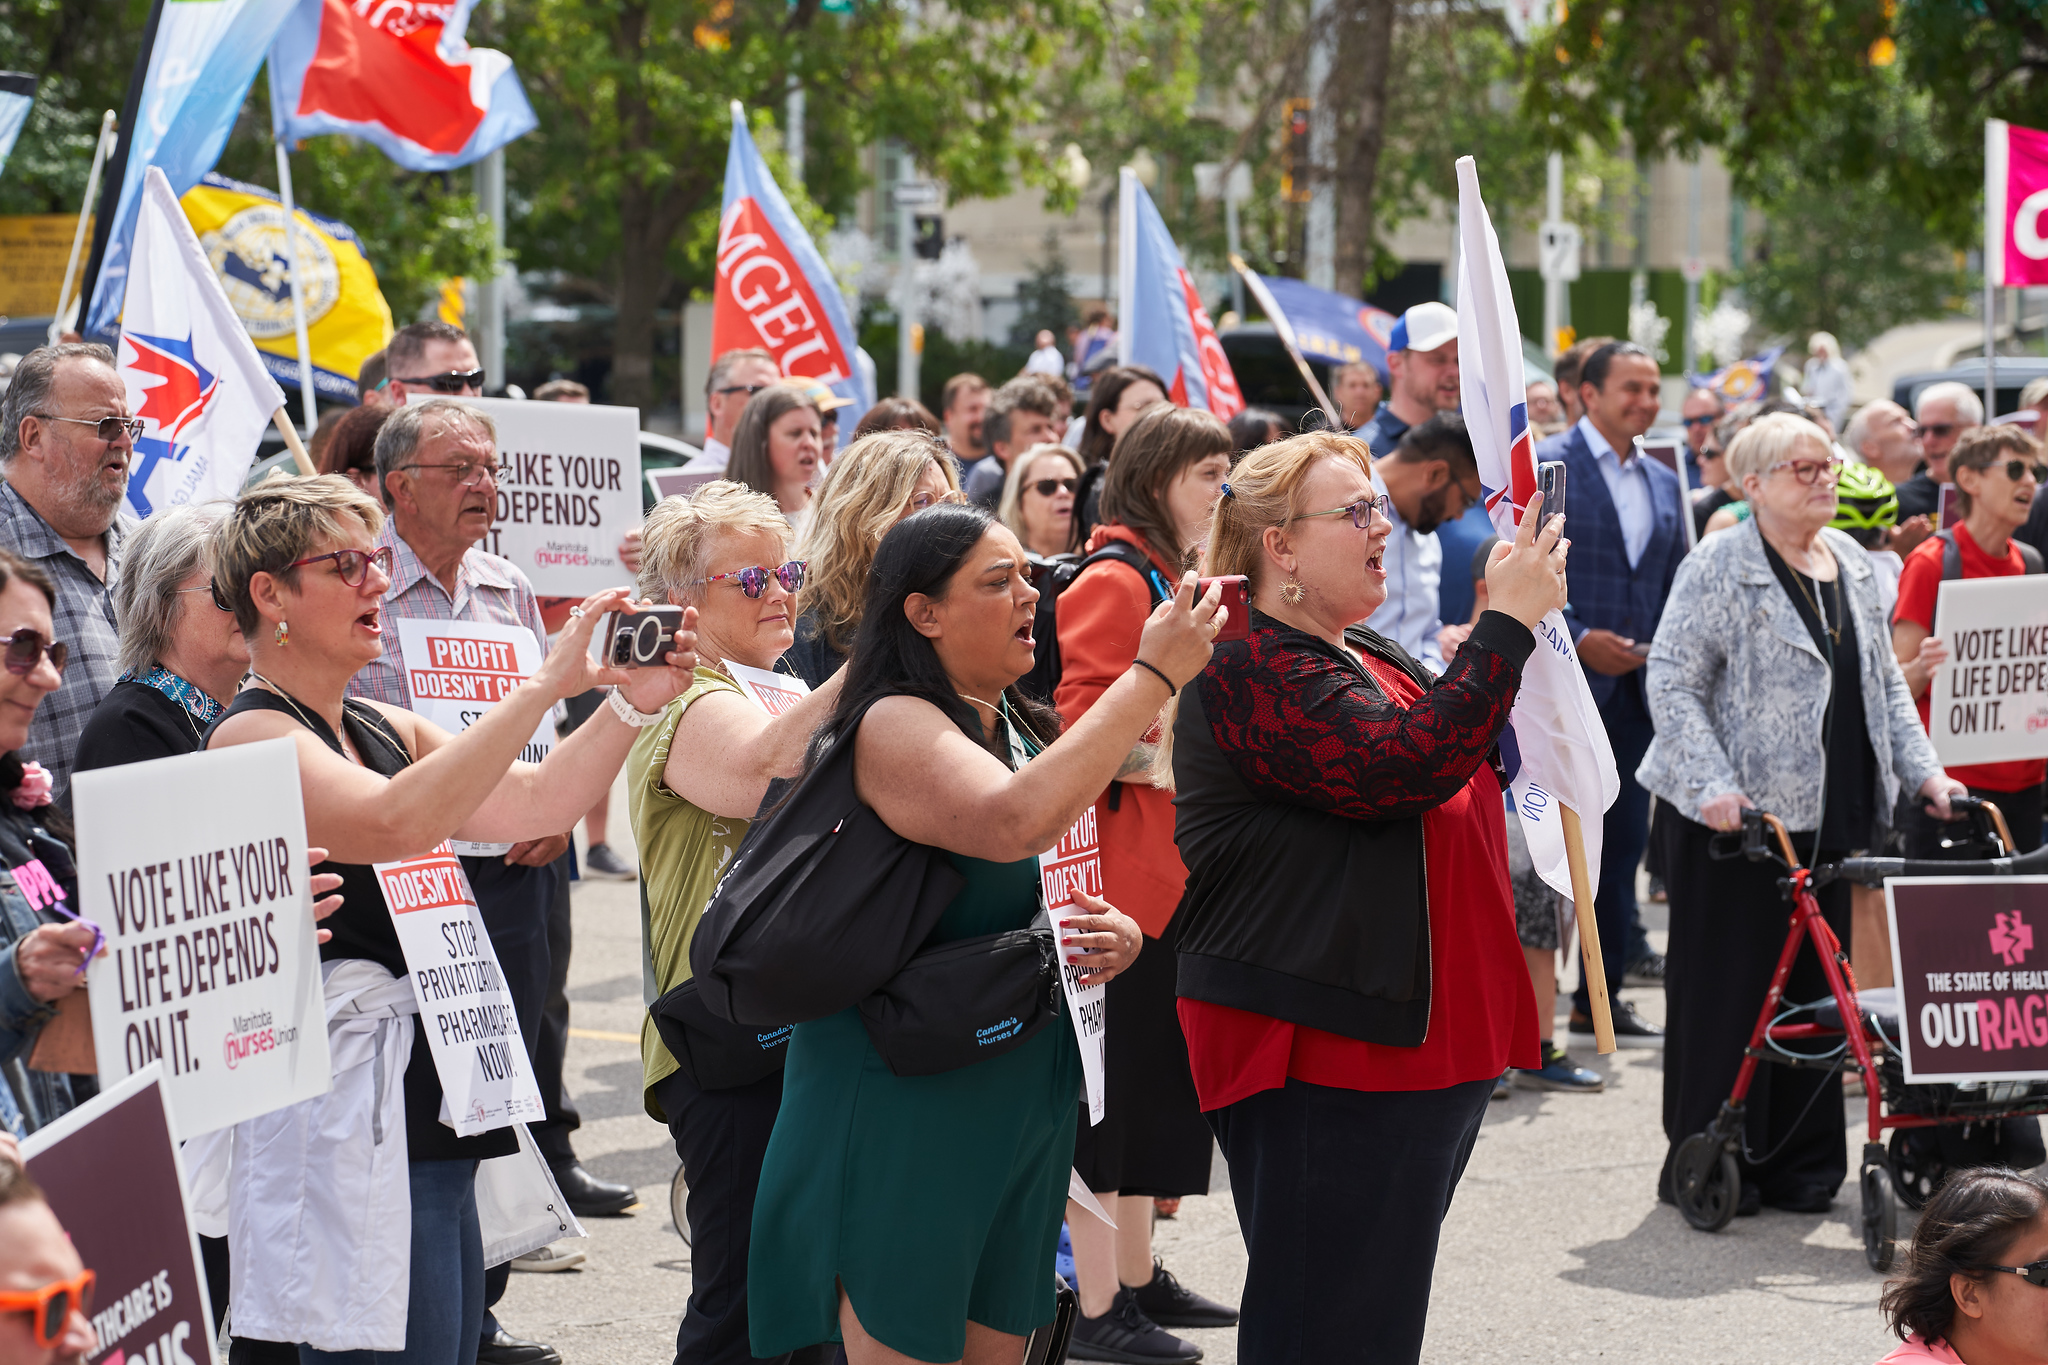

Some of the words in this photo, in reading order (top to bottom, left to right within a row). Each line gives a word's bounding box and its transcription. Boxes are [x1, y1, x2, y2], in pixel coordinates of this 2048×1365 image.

[502, 452, 553, 486] LIKE
[559, 455, 621, 490] YOUR
[496, 491, 602, 527] DEPENDS
[538, 552, 588, 567] nurses
[546, 541, 588, 553] Manitoba
[433, 639, 509, 670] PROFIT
[1954, 628, 2002, 661] VOTE
[413, 672, 491, 699] DOESN'T
[1953, 666, 1991, 698] LIFE
[1950, 703, 1977, 734] ON
[1983, 701, 2005, 731] IT.
[108, 861, 175, 936] VOTE
[178, 850, 230, 921] LIKE
[230, 837, 293, 907] YOUR
[386, 866, 458, 910] DOESN'T
[441, 920, 479, 959] STOP
[117, 939, 172, 1013] LIFE
[175, 912, 279, 998] DEPENDS
[1926, 972, 1953, 992] THE
[1953, 972, 1992, 992] STATE
[1992, 971, 2010, 991] OF
[233, 1008, 272, 1034] Manitoba
[757, 1024, 794, 1042] Canada's
[976, 1016, 1017, 1038] Canada's
[126, 1016, 163, 1076] ON
[169, 1009, 199, 1076] IT.
[226, 1028, 274, 1063] nurses
[274, 1025, 298, 1046] Union
[761, 1034, 791, 1050] Nurses
[978, 1030, 1012, 1046] Nurses
[152, 1269, 172, 1311] IS
